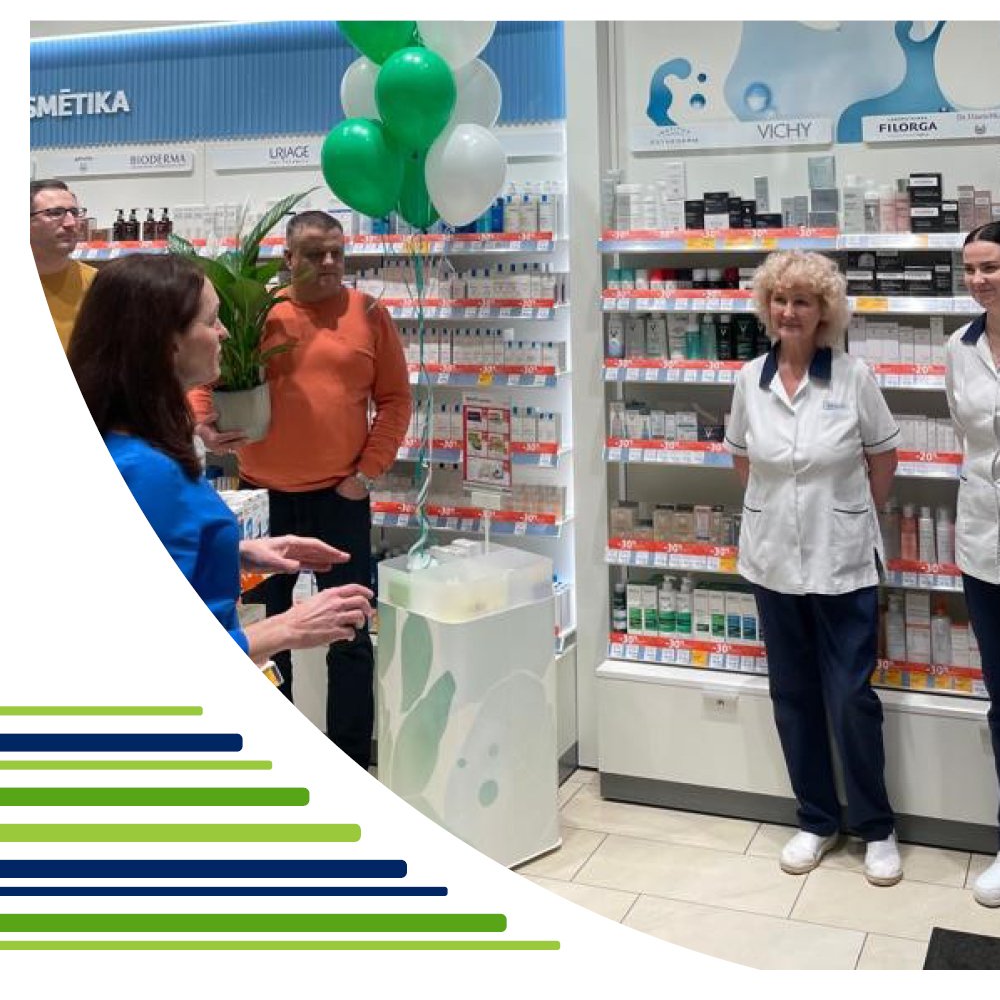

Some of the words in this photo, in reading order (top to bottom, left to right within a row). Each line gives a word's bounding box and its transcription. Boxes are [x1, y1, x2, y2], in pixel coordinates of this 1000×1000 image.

[757, 121, 812, 139] VICHY
[879, 121, 938, 133] FILORGA
[129, 153, 187, 166] BIODERMA
